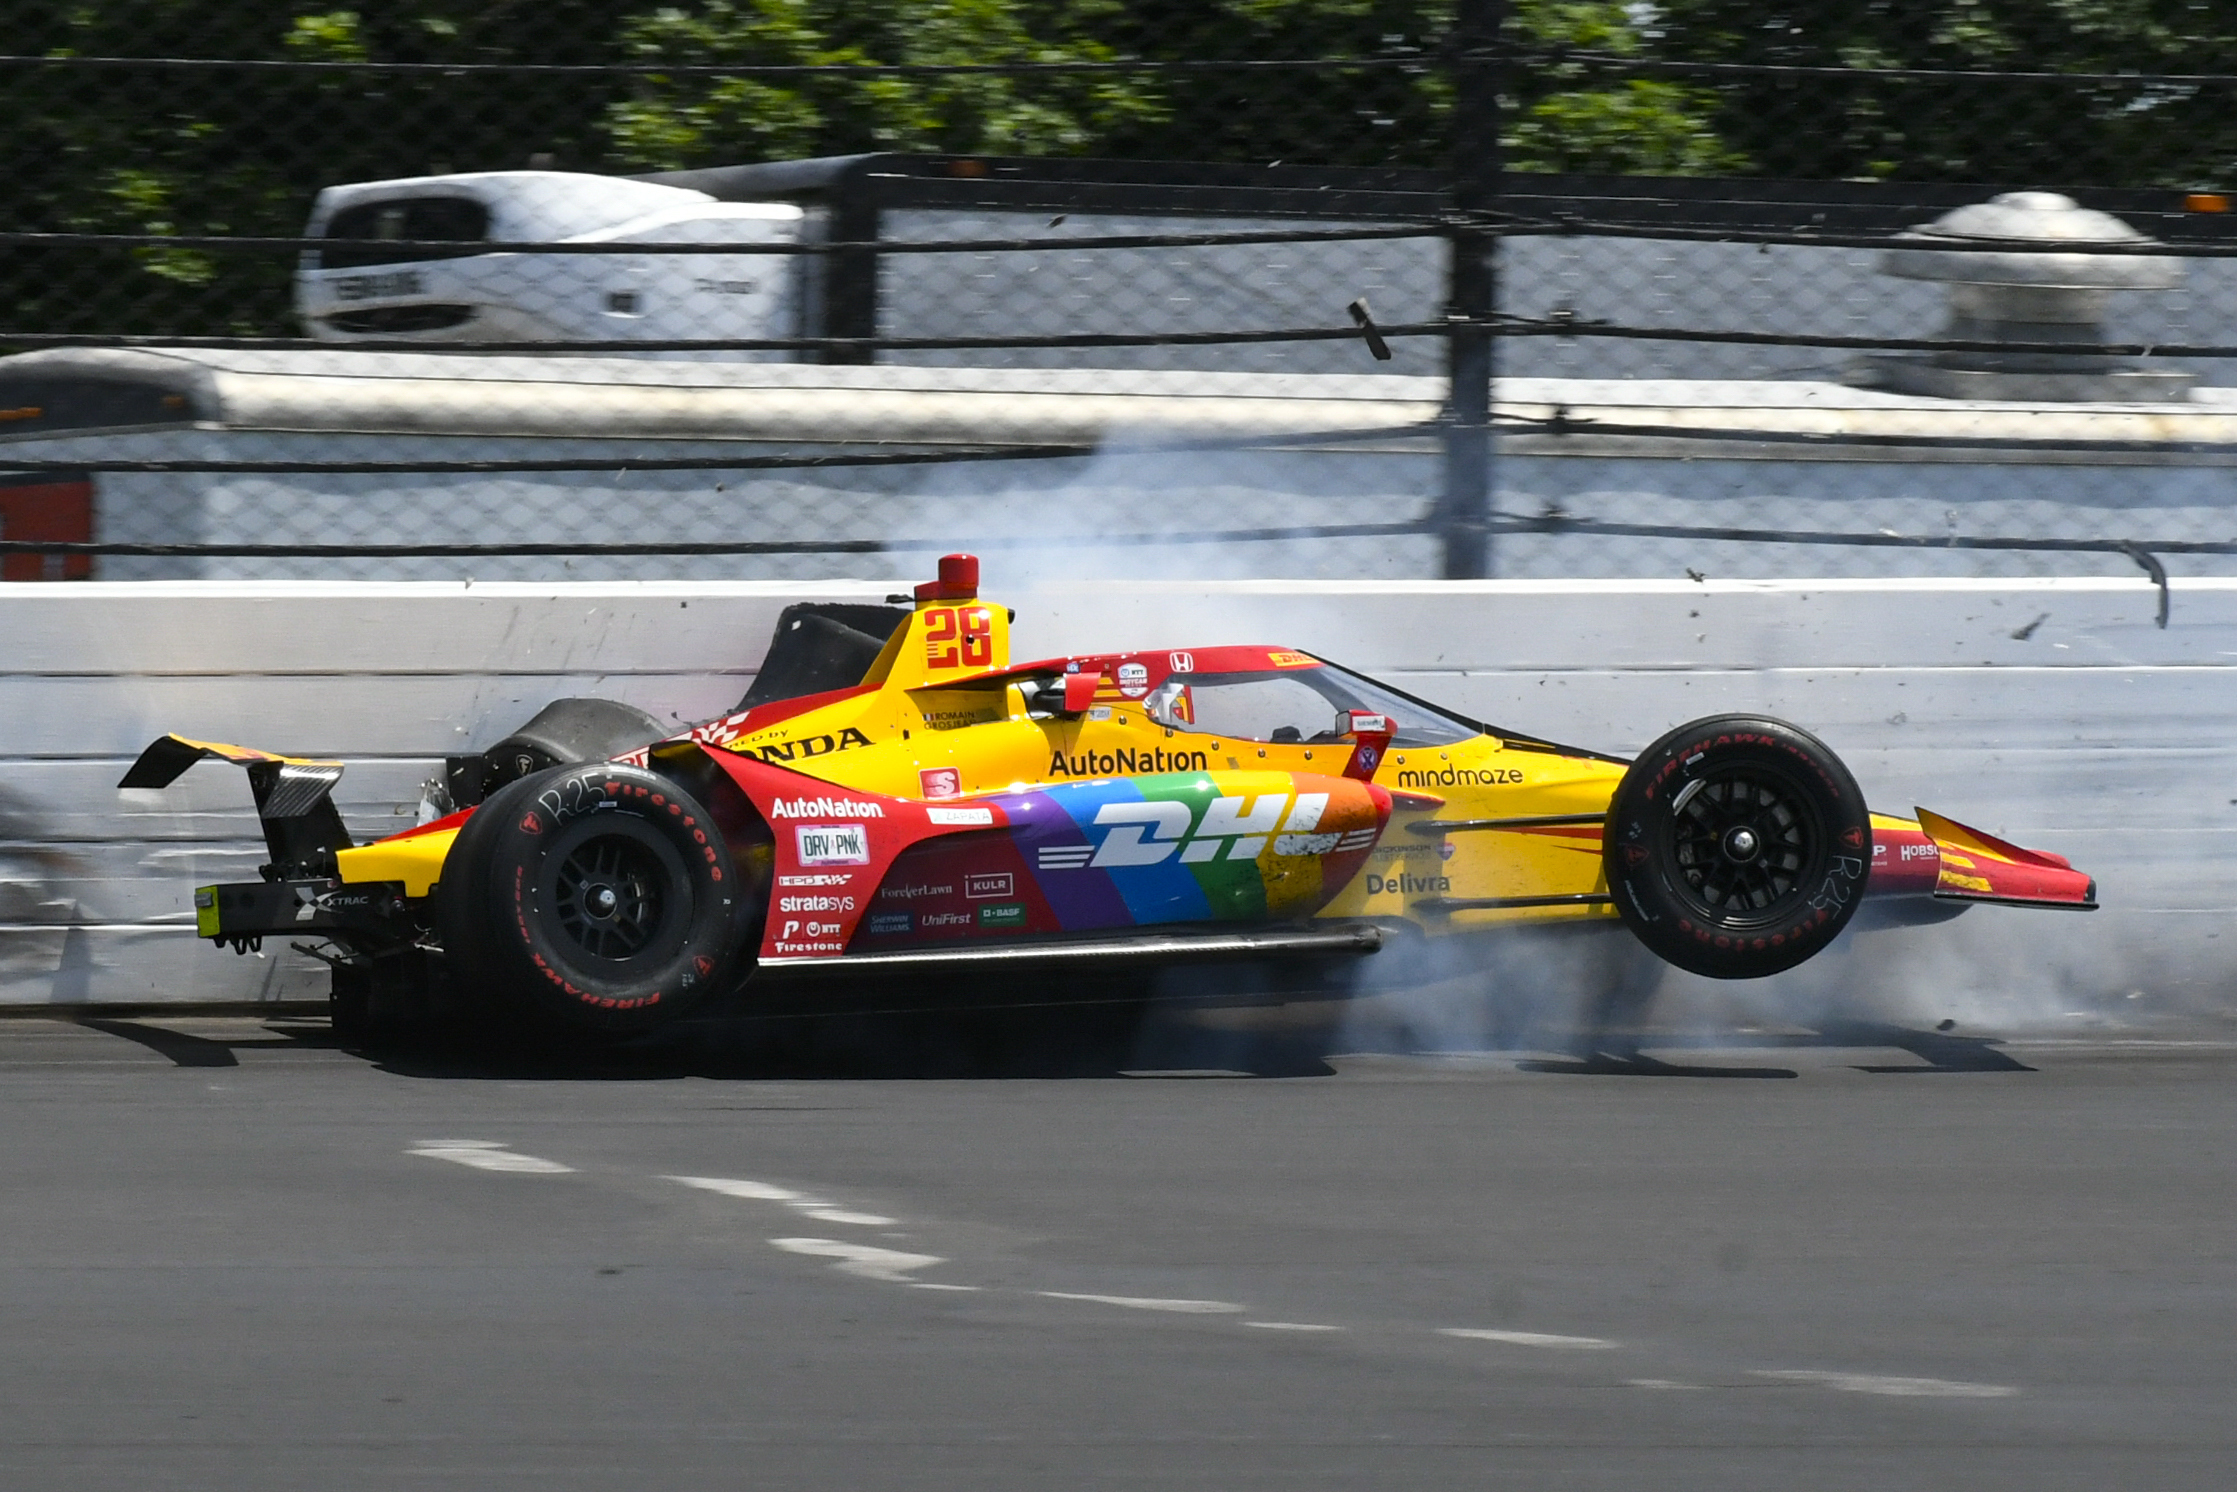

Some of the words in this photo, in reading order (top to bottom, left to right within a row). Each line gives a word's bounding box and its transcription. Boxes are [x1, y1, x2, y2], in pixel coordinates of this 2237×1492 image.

[924, 606, 992, 669] 28
[935, 711, 975, 720] ROMAIN
[769, 729, 789, 740] by
[1049, 746, 1208, 777] AutoNation
[1398, 763, 1524, 788] mindmaze
[771, 796, 884, 819] AutoNation
[604, 781, 723, 882] Firestone
[1089, 793, 1344, 868] DHL
[803, 834, 829, 857] DRV
[835, 833, 862, 855] PNK
[973, 880, 1006, 891] KULR
[1366, 872, 1451, 895] Delivra
[327, 896, 369, 907] XTRAC
[780, 895, 855, 914] stratasys
[996, 907, 1021, 917] BASF
[921, 912, 972, 927] UniFirst
[775, 941, 843, 954] Firestone
